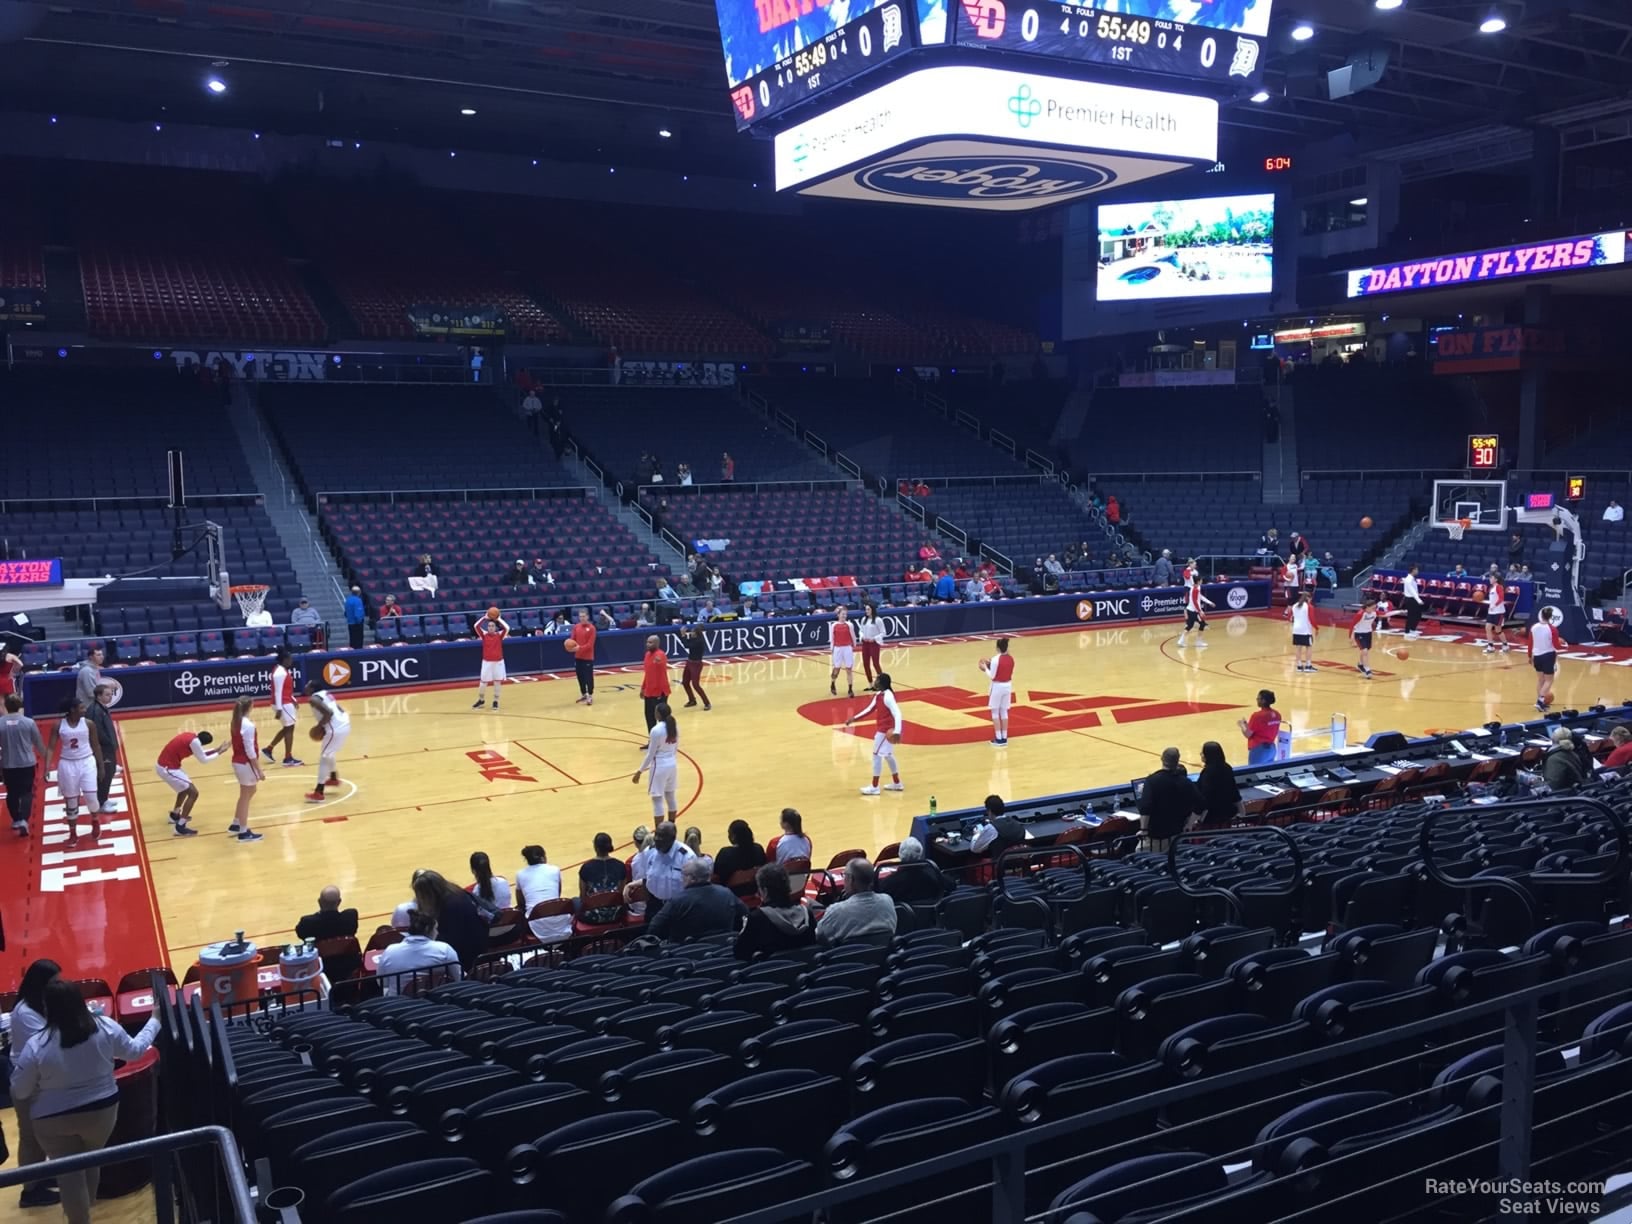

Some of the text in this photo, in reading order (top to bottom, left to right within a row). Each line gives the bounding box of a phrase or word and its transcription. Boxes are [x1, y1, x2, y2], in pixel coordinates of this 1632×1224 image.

[1076, 7, 1095, 17] FOULS
[1021, 8, 1039, 42] 0
[1060, 18, 1089, 37] 4 0
[1096, 14, 1151, 44] 55:49
[830, 38, 848, 60] 0 4
[858, 25, 872, 57] 0
[1157, 32, 1183, 51] 0 4
[795, 43, 826, 77] 55:49
[1111, 46, 1133, 61] 1ST
[1200, 37, 1216, 68] 0
[777, 68, 793, 88] 4 0
[807, 73, 821, 90] 1ST
[759, 79, 770, 107] 0
[1047, 98, 1177, 132] Premier Health
[1266, 157, 1291, 170] 6:04
[1366, 239, 1594, 292] DAYTON FLYERS
[1472, 438, 1496, 448] 55:49
[1475, 448, 1493, 465] 30
[1095, 599, 1130, 616] PNC
[1154, 597, 1178, 606] Premier
[663, 622, 807, 656] UNVERSITY
[809, 624, 822, 641] of
[203, 671, 255, 686] Premier
[359, 658, 419, 681] PNC
[204, 687, 233, 696] Miami
[234, 682, 259, 694] Valley
[70, 738, 79, 749] 2
[214, 976, 232, 994] G
